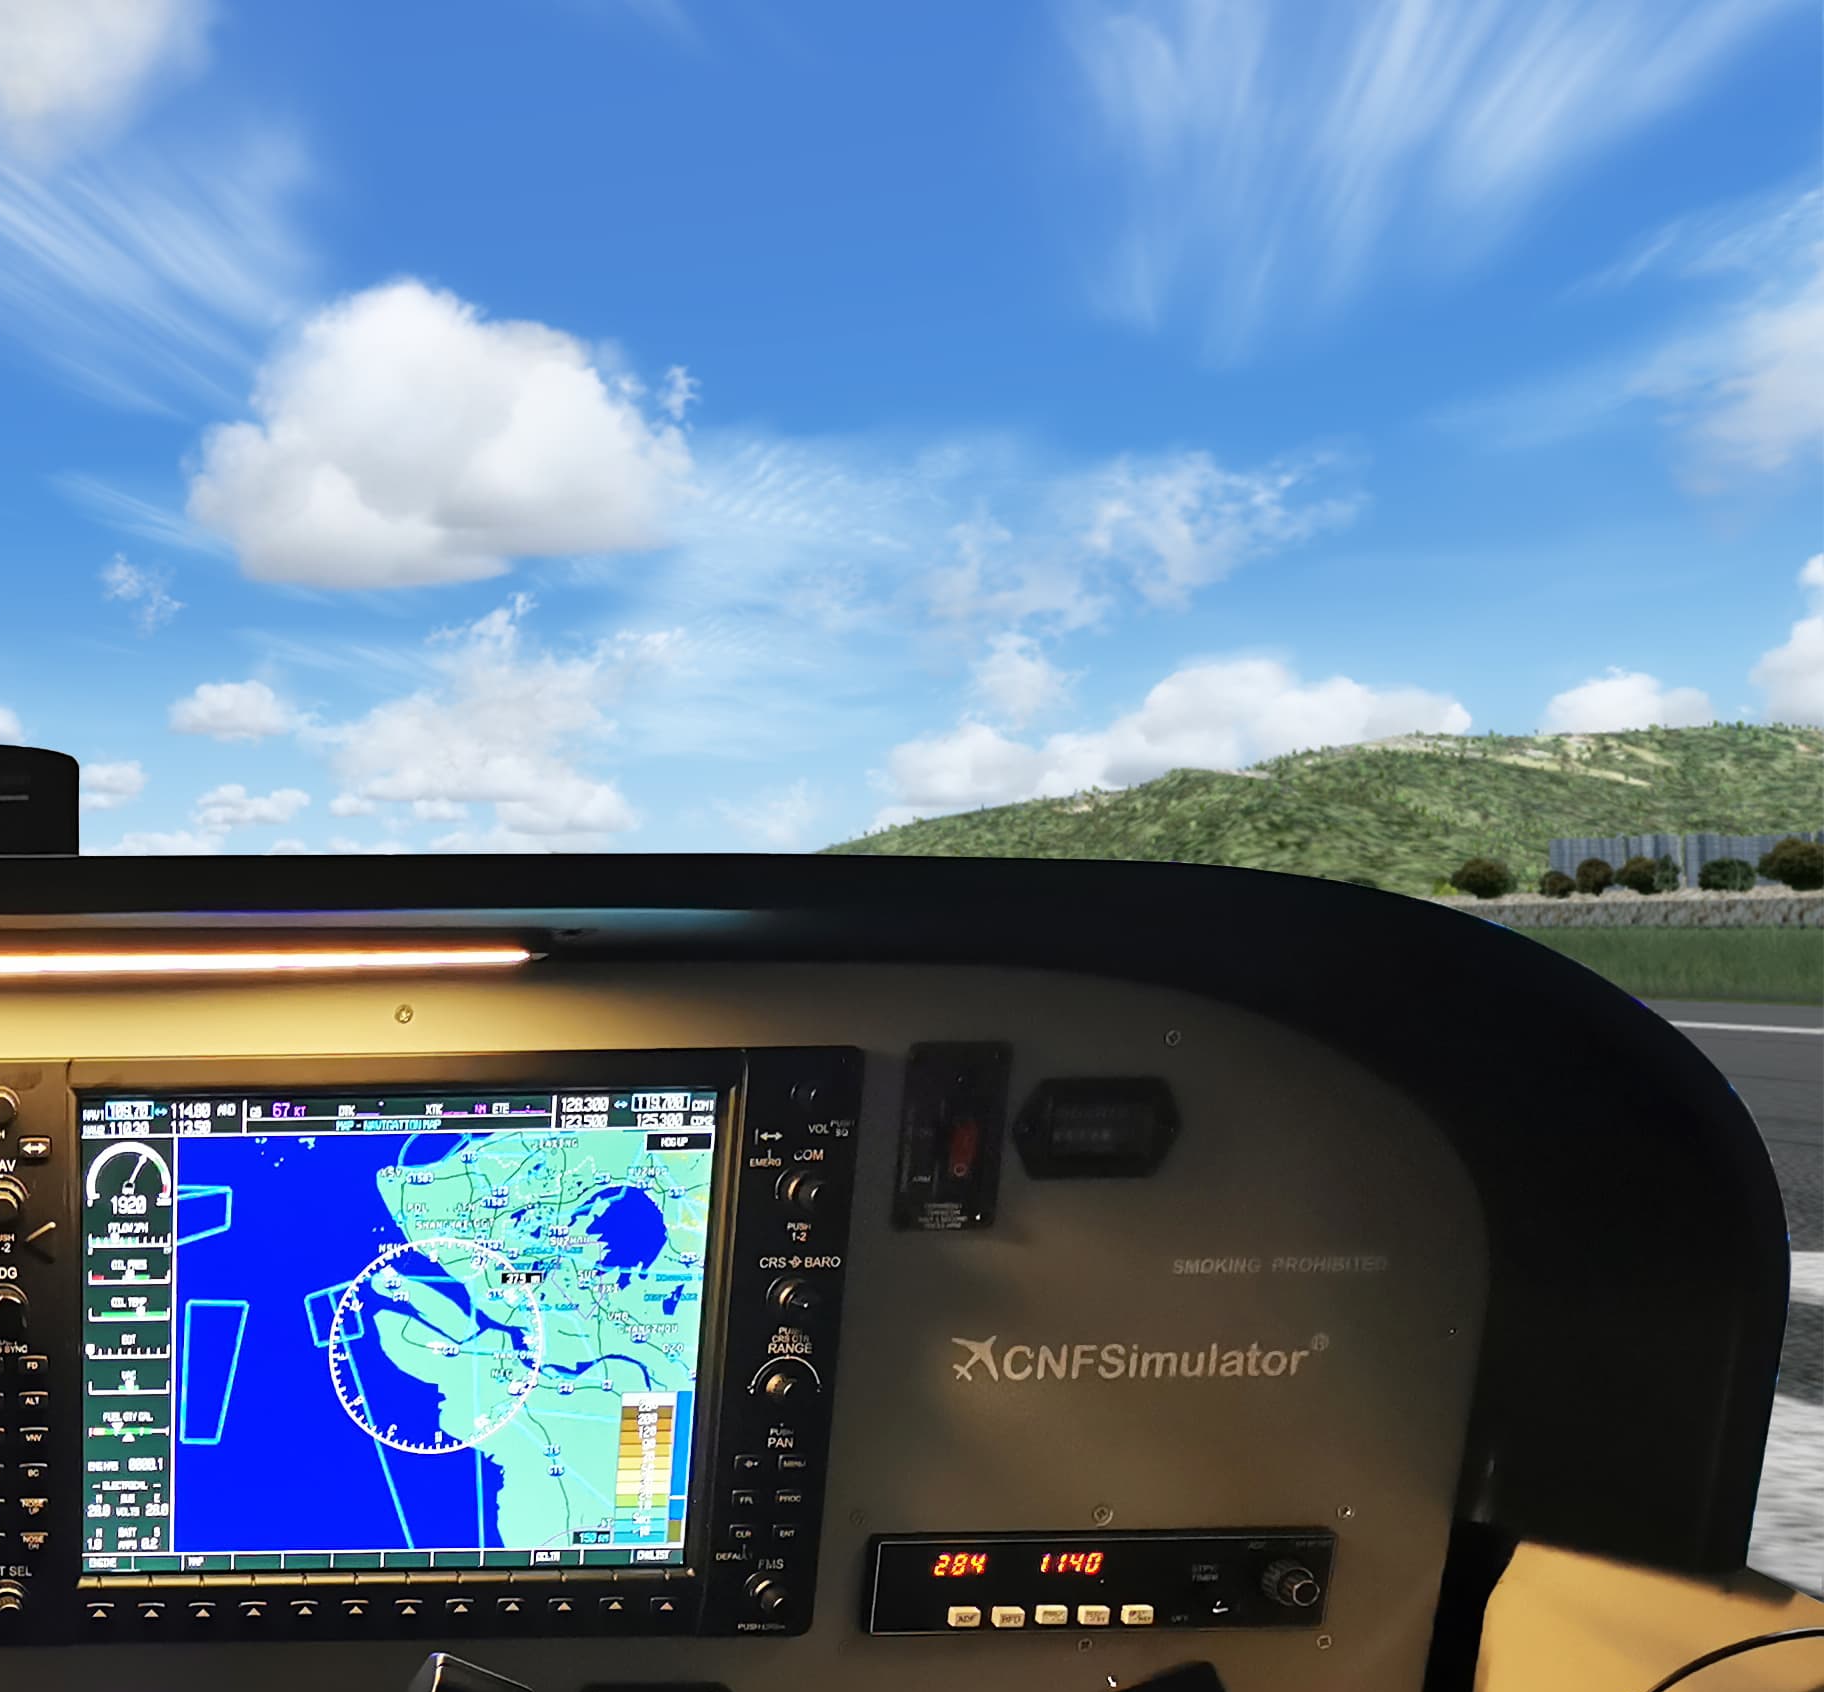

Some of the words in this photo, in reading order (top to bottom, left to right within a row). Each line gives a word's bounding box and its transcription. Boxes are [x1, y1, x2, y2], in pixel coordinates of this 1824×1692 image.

[272, 1104, 290, 1117] 67
[294, 1106, 306, 1116] KT
[561, 1097, 609, 1111] 128.300
[808, 1124, 829, 1134] VOL
[793, 1150, 823, 1161] COM
[750, 1158, 781, 1167] EMERG
[111, 1196, 146, 1214] 1920
[787, 1222, 811, 1231] PUSH
[792, 1232, 807, 1242] 1-2
[760, 1257, 786, 1268] CRS
[804, 1257, 840, 1268] BARO
[1172, 1258, 1262, 1275] SMOKING
[1271, 1256, 1389, 1274] PROHIBITED
[768, 1343, 813, 1354] RANGE
[27, 1361, 38, 1369] FD
[25, 1397, 40, 1405] ALT
[26, 1434, 42, 1442] VNV
[767, 1437, 794, 1448] PAN
[780, 1530, 795, 1538] ENT
[758, 1559, 784, 1570] FMS
[933, 1553, 988, 1577] 284
[1040, 1552, 1104, 1575] 1140
[9, 1566, 32, 1576] SEL
